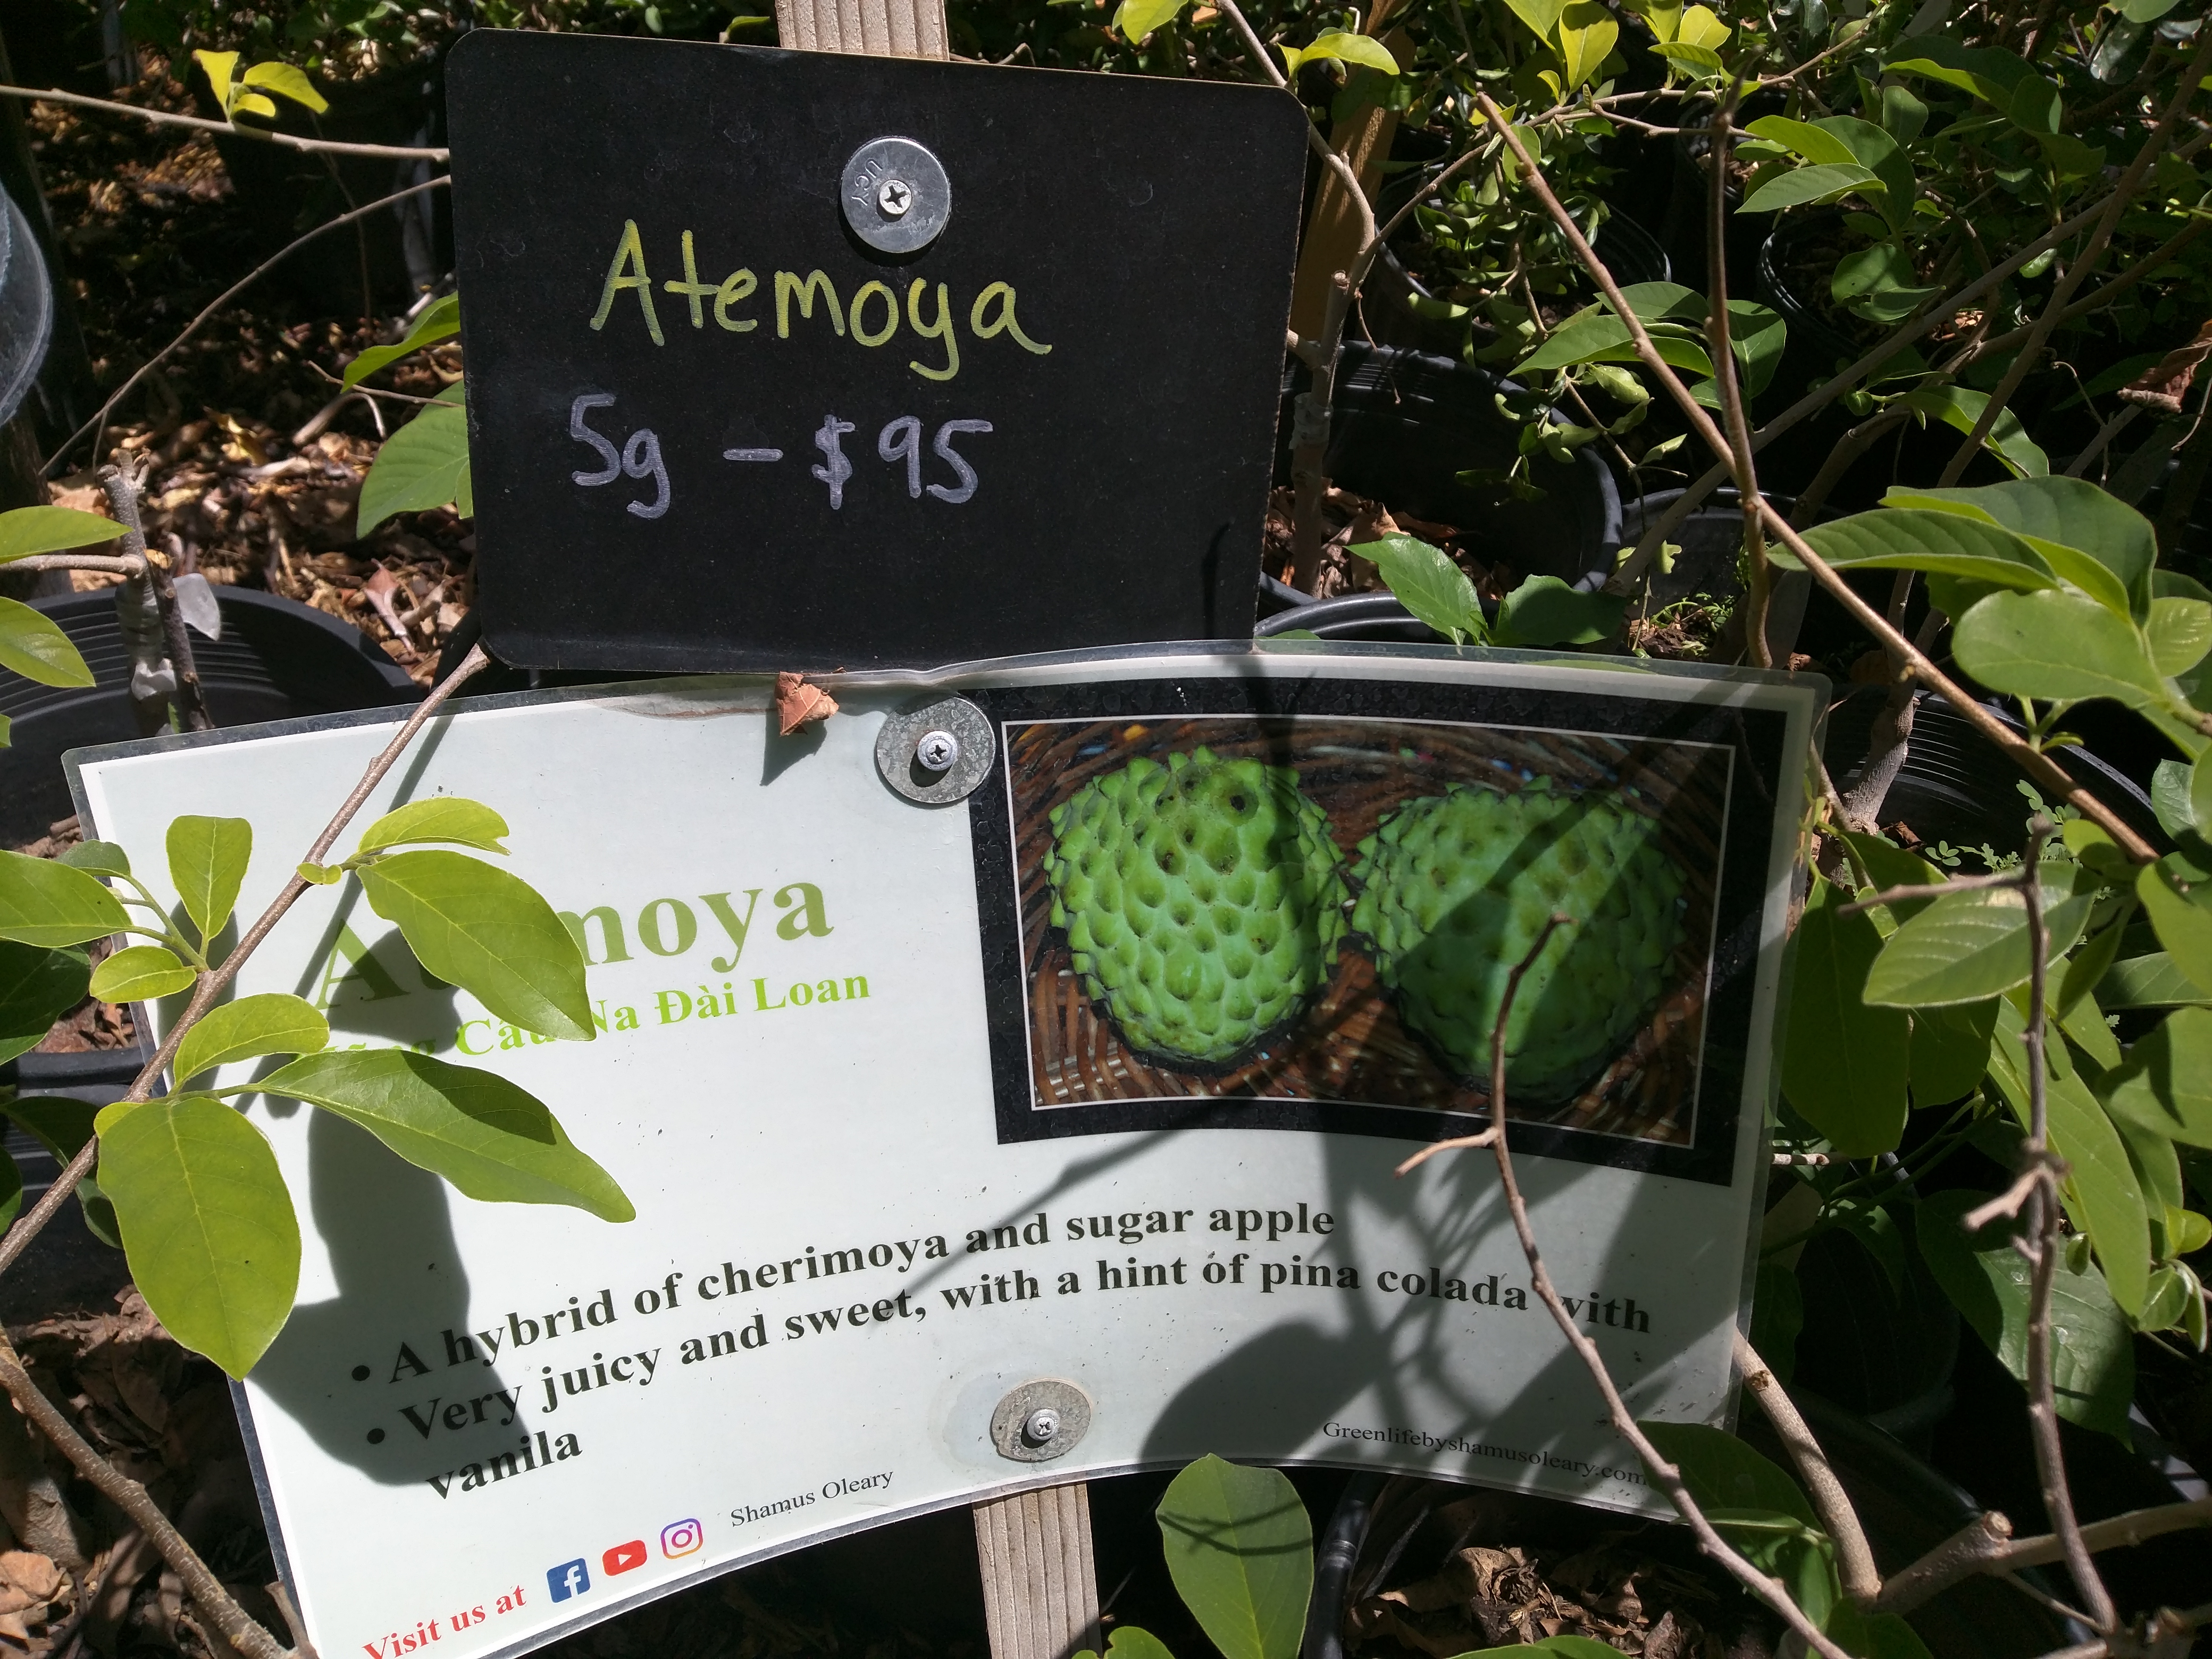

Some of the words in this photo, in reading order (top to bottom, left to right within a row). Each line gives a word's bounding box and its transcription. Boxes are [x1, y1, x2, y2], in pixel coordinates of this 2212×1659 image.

[590, 219, 1052, 381] Atemoya
[314, 881, 835, 1010] Amoya
[652, 982, 738, 1025] Đài
[751, 975, 870, 1012] Loan
[389, 1342, 432, 1384] A
[440, 1288, 618, 1367] hybrid
[633, 1271, 683, 1316] of
[698, 1235, 950, 1301] cherimoya
[965, 1212, 1051, 1254] and
[1067, 1210, 1194, 1245] sugar
[1209, 1203, 1335, 1242] apple
[399, 1385, 522, 1440] Very
[541, 1347, 661, 1412] juicy
[680, 1315, 769, 1365] and
[786, 1289, 927, 1341] sweet,
[941, 1269, 1042, 1310] with
[1057, 1272, 1082, 1295] a
[1098, 1256, 1187, 1291] hint
[1203, 1253, 1251, 1284] of
[1261, 1255, 1360, 1293] pina
[1377, 1268, 1528, 1310] colada
[425, 1427, 583, 1501] vanila
[731, 1491, 816, 1528] Shamus
[822, 1471, 894, 1499] Oleary
[362, 1619, 442, 1659] Visit
[450, 1605, 486, 1632] us
[496, 1585, 527, 1615] at
